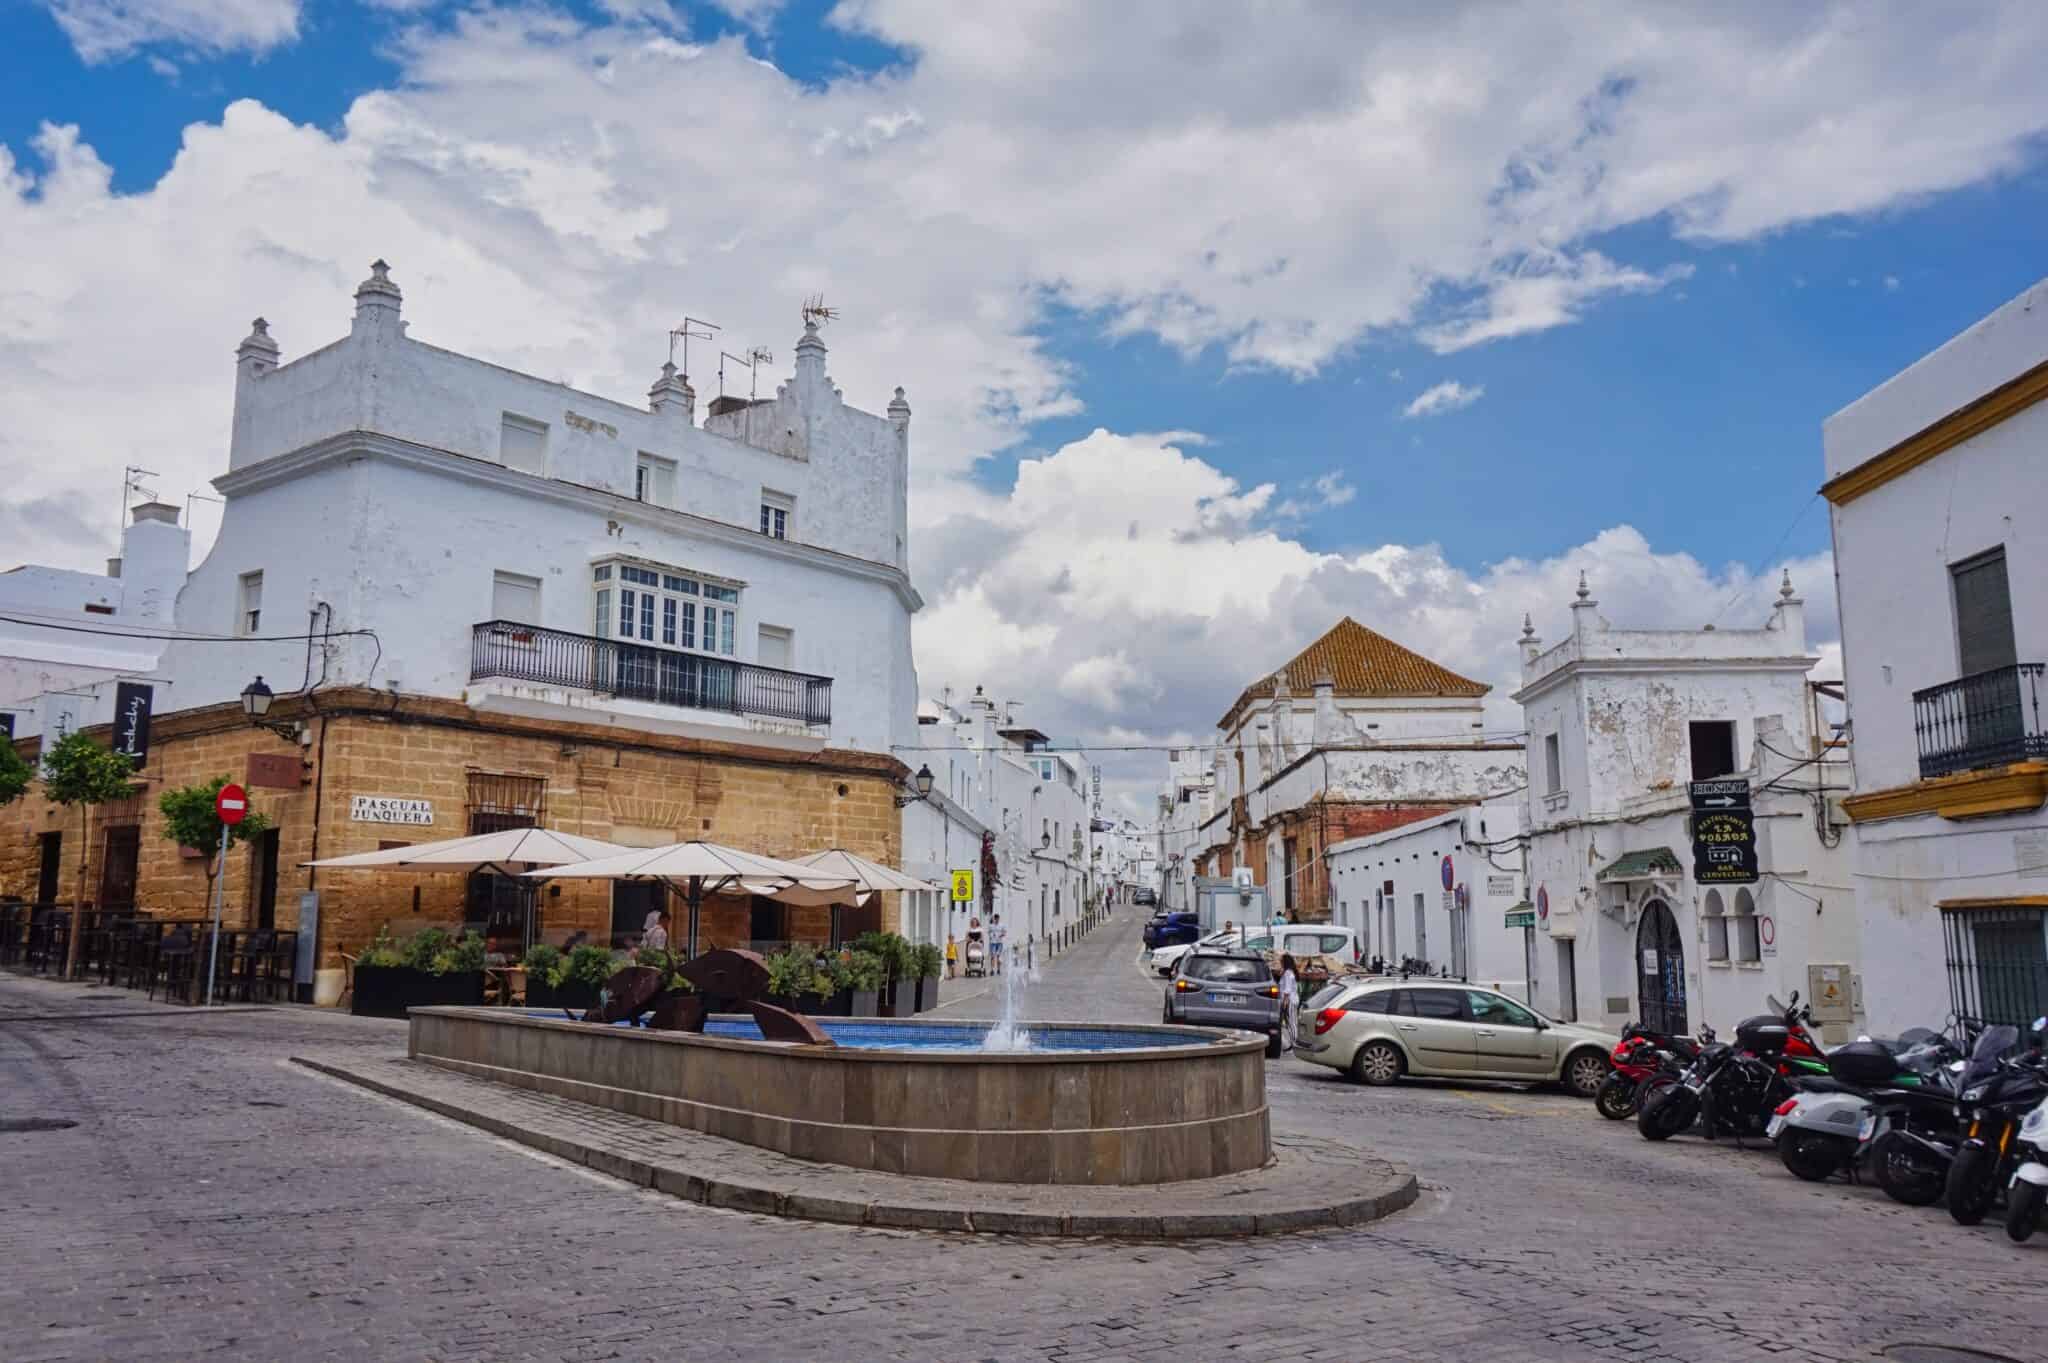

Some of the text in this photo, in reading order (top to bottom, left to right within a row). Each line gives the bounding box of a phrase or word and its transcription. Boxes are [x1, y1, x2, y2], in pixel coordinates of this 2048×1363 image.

[1694, 783, 1747, 794] HOSTAL
[358, 798, 429, 812] PASCUAL
[353, 810, 432, 823] JUNQUERA
[1713, 824, 1732, 833] LA
[1698, 832, 1748, 842] POSADA
[1717, 864, 1734, 872] BAR
